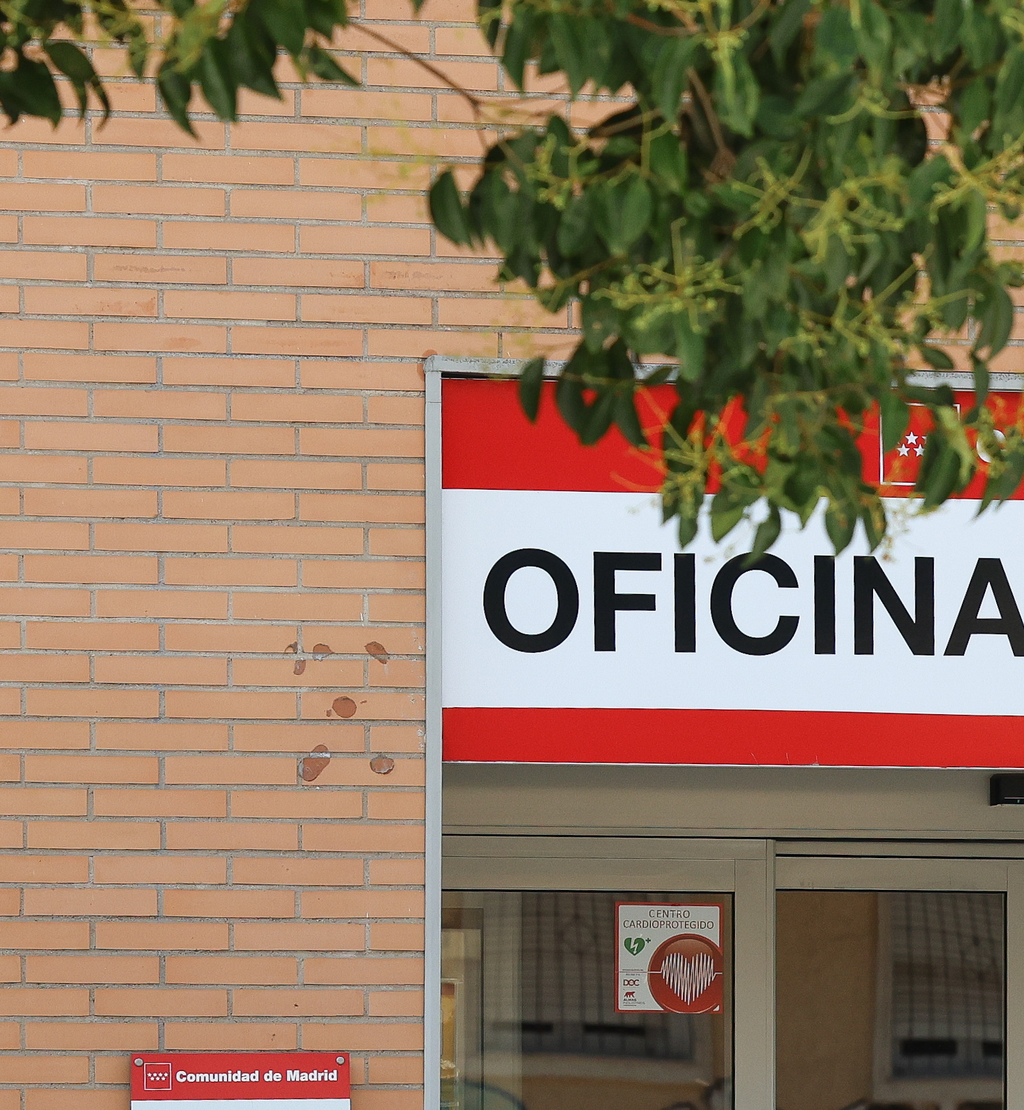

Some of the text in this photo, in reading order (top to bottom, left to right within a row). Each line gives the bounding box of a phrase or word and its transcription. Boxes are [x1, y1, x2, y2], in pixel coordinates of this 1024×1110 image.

[648, 909, 691, 919] CENTRO
[622, 919, 715, 930] CARDIOPROTEGIDO
[175, 1069, 339, 1083] Comunidad de Madrid
